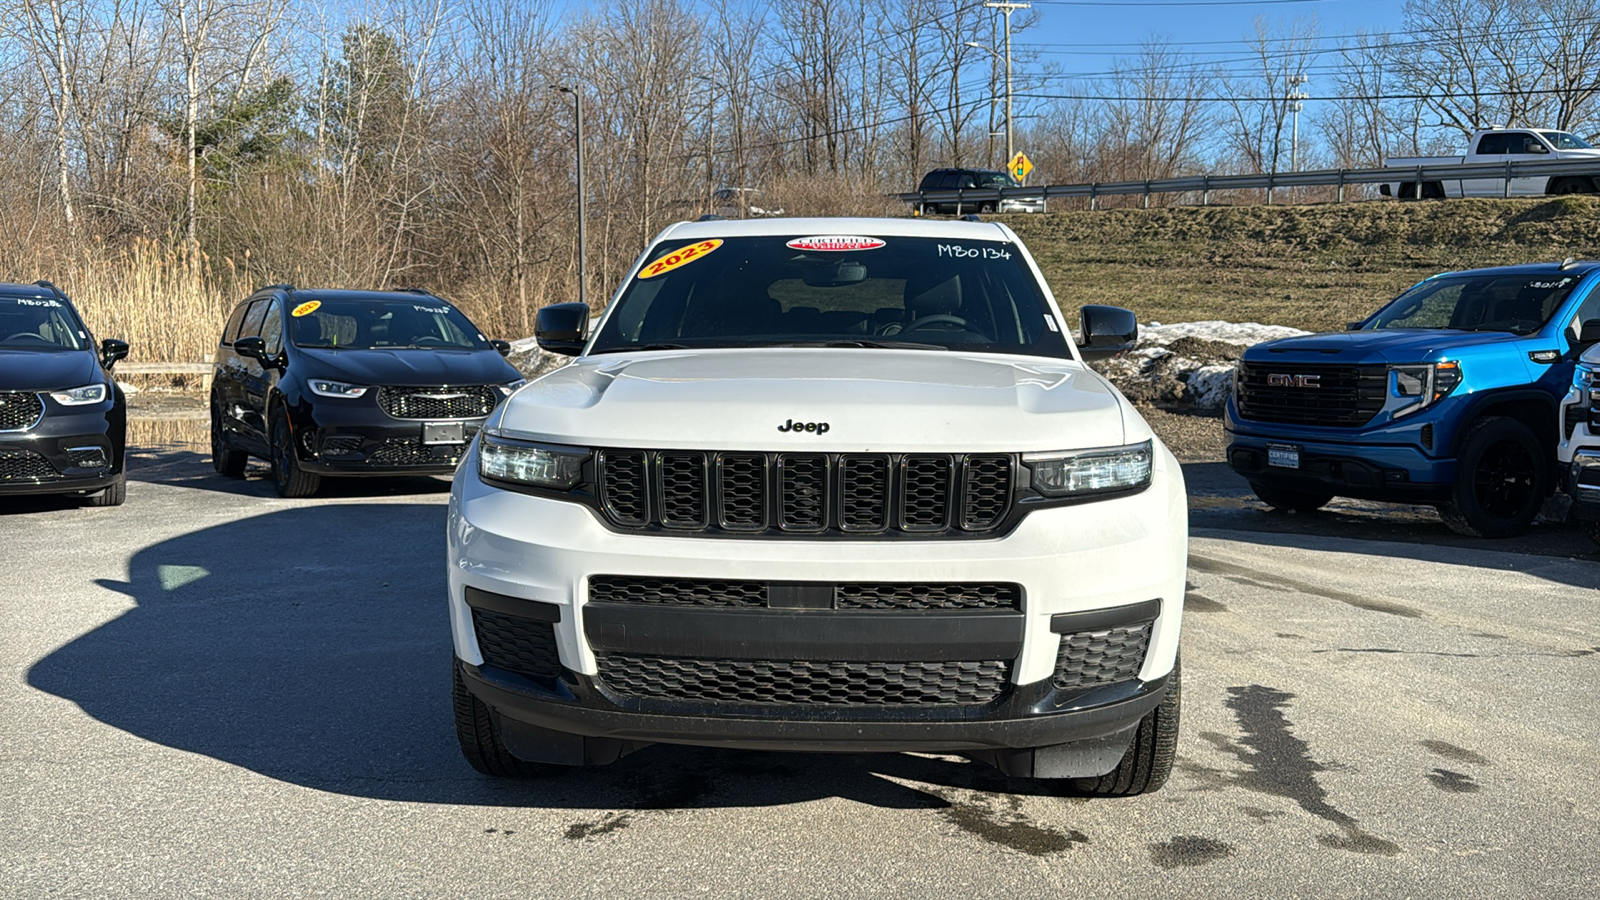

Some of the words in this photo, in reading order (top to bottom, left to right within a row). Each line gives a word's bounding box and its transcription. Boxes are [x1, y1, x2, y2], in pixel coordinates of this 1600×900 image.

[648, 241, 715, 275] 2023
[1267, 373, 1321, 388] GMC
[777, 418, 830, 435] Jeep
[1268, 450, 1299, 460] CERTIFIED
